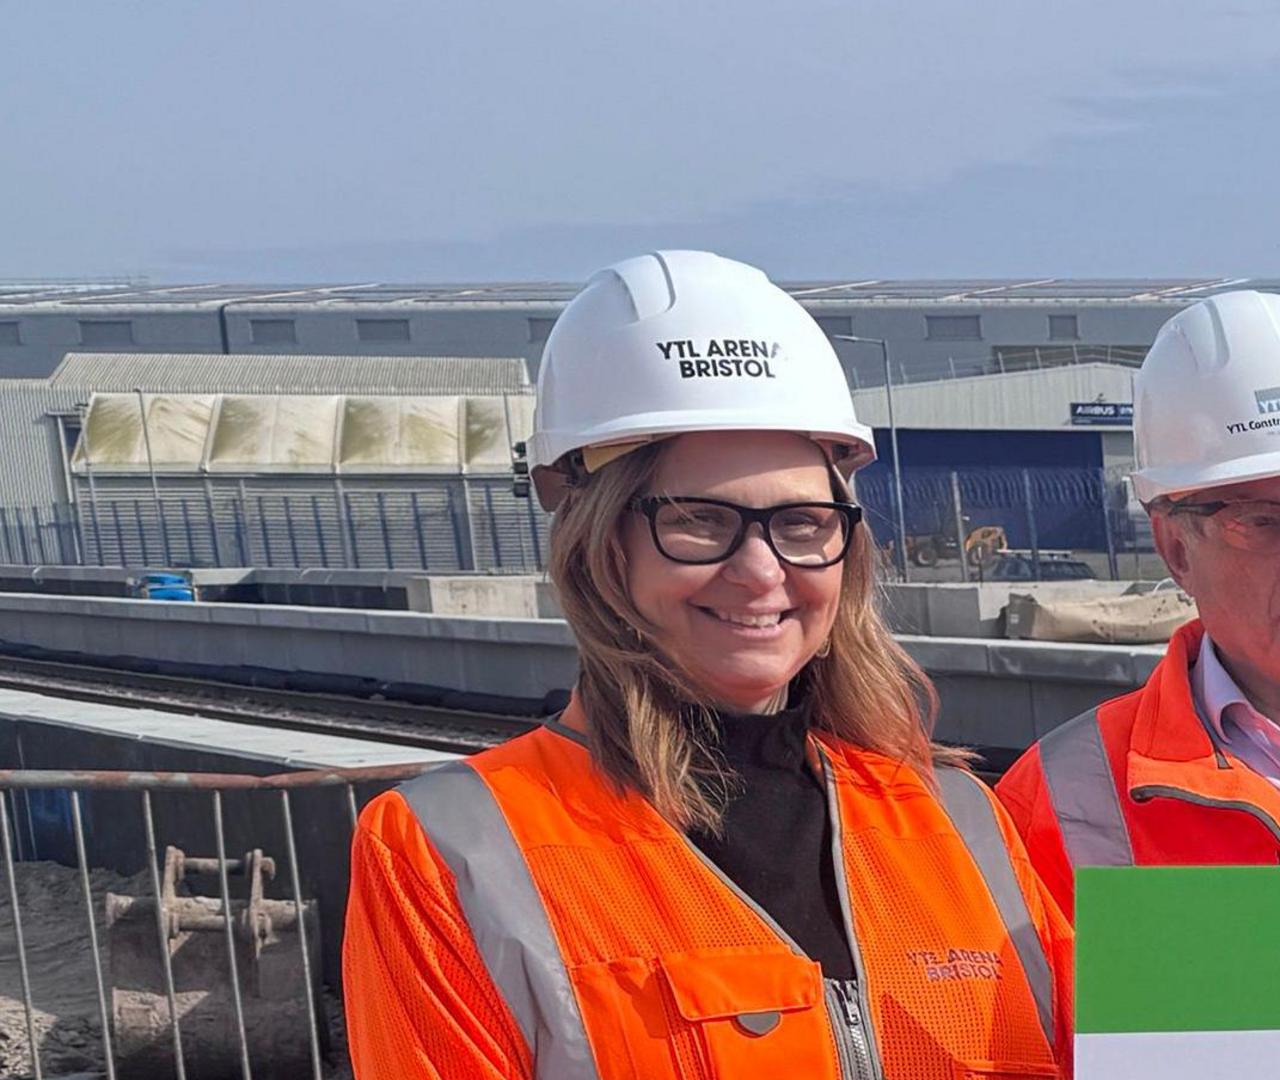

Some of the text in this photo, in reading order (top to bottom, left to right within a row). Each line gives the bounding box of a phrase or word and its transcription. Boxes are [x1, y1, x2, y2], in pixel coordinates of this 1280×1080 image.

[656, 340, 700, 360] YTL
[679, 359, 776, 379] BRISTOL
[1226, 421, 1249, 435] YTL
[927, 963, 1003, 982] BRISTOL
